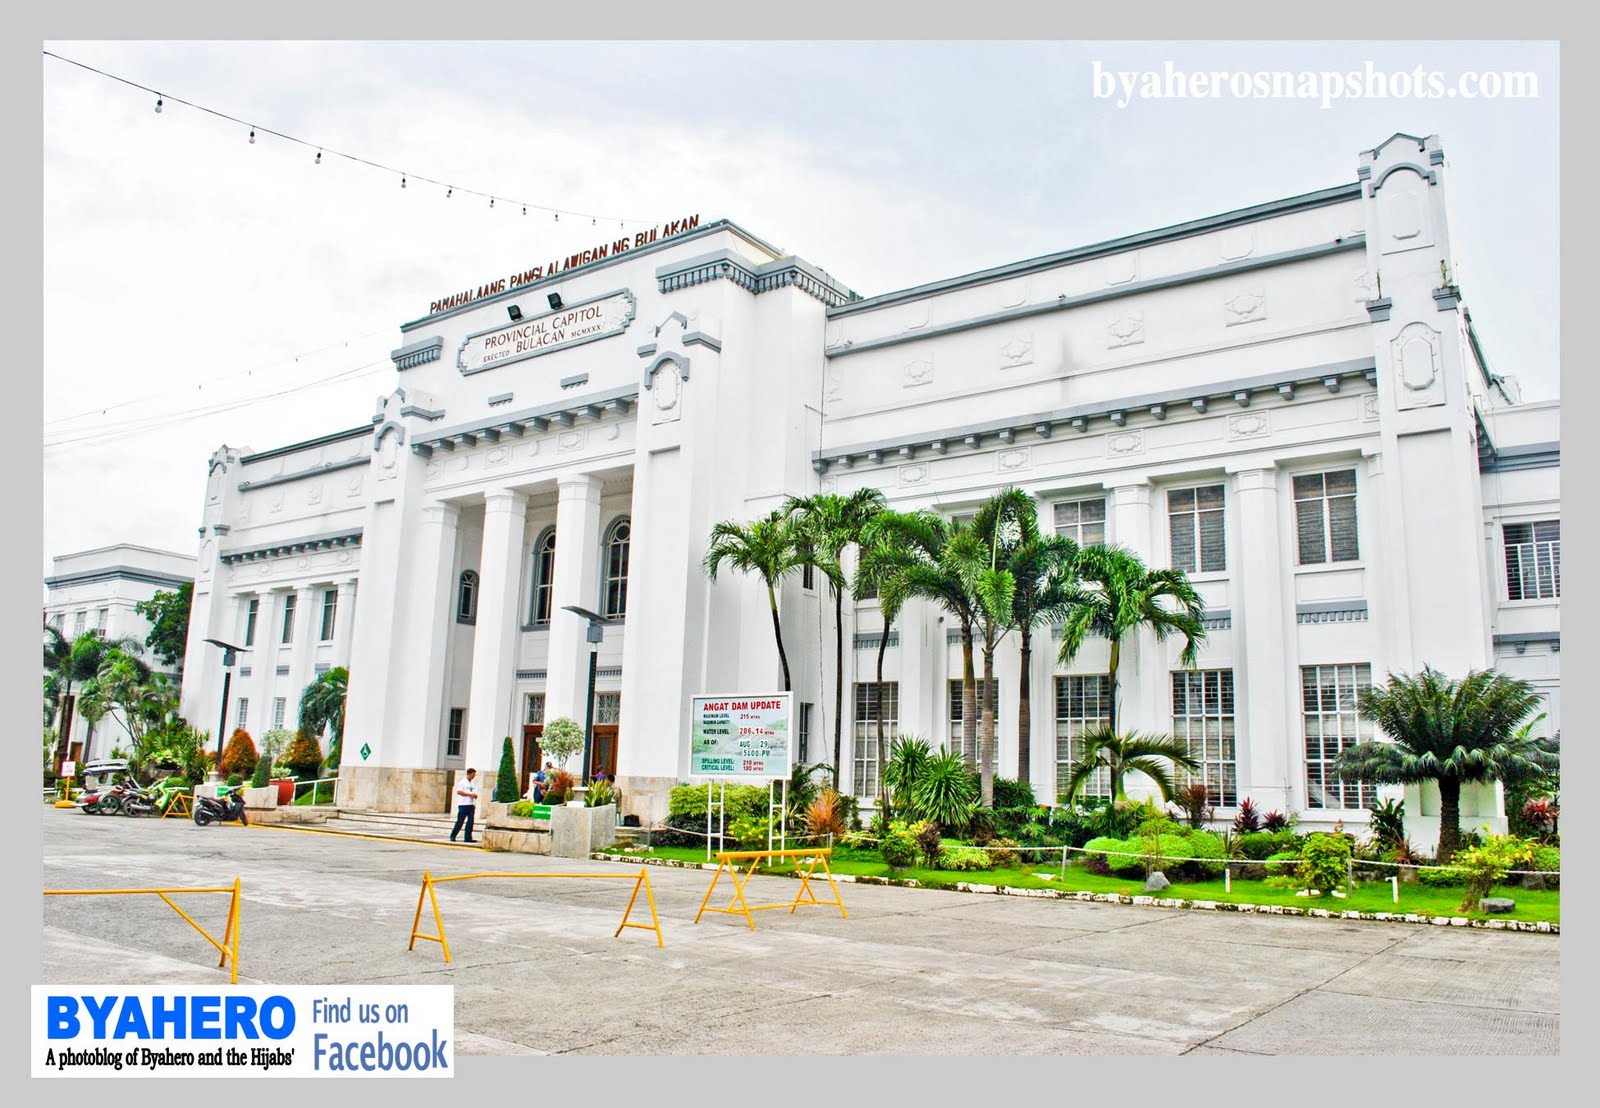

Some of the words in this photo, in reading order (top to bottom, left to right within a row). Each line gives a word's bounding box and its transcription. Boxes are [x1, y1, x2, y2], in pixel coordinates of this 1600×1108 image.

[430, 279, 505, 314] PAMAHALAANG
[510, 244, 608, 287] PANGLALAWIGAN
[612, 238, 629, 254] NG
[635, 214, 699, 248] BULAKAN
[483, 350, 510, 363] ERECTED
[516, 329, 566, 353] BULACAN
[571, 324, 601, 338] MCMXXX
[484, 321, 548, 350] PROVINCIAL
[552, 305, 603, 329] CAPITOL
[703, 702, 729, 711] ANGAT
[731, 702, 748, 710] DAM
[751, 701, 781, 710] UPDATE
